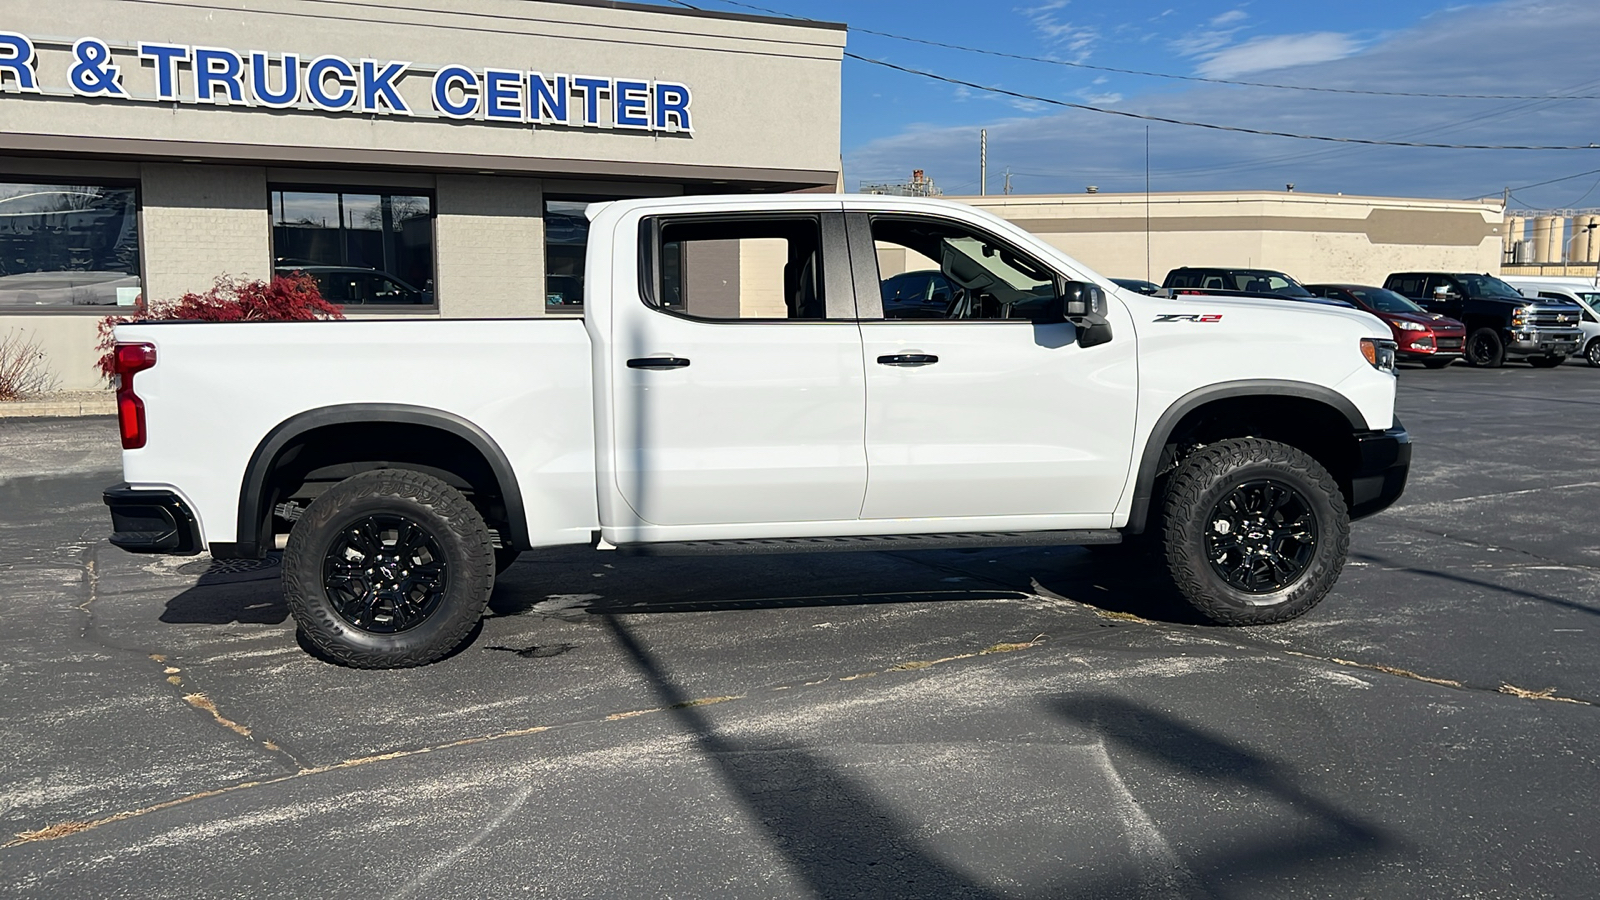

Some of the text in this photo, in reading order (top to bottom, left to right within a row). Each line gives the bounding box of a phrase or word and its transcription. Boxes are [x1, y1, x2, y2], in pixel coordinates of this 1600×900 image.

[67, 37, 131, 98] &
[138, 41, 414, 115] TRUCK
[432, 64, 694, 132] CENTER
[1152, 314, 1223, 323] ZR2
